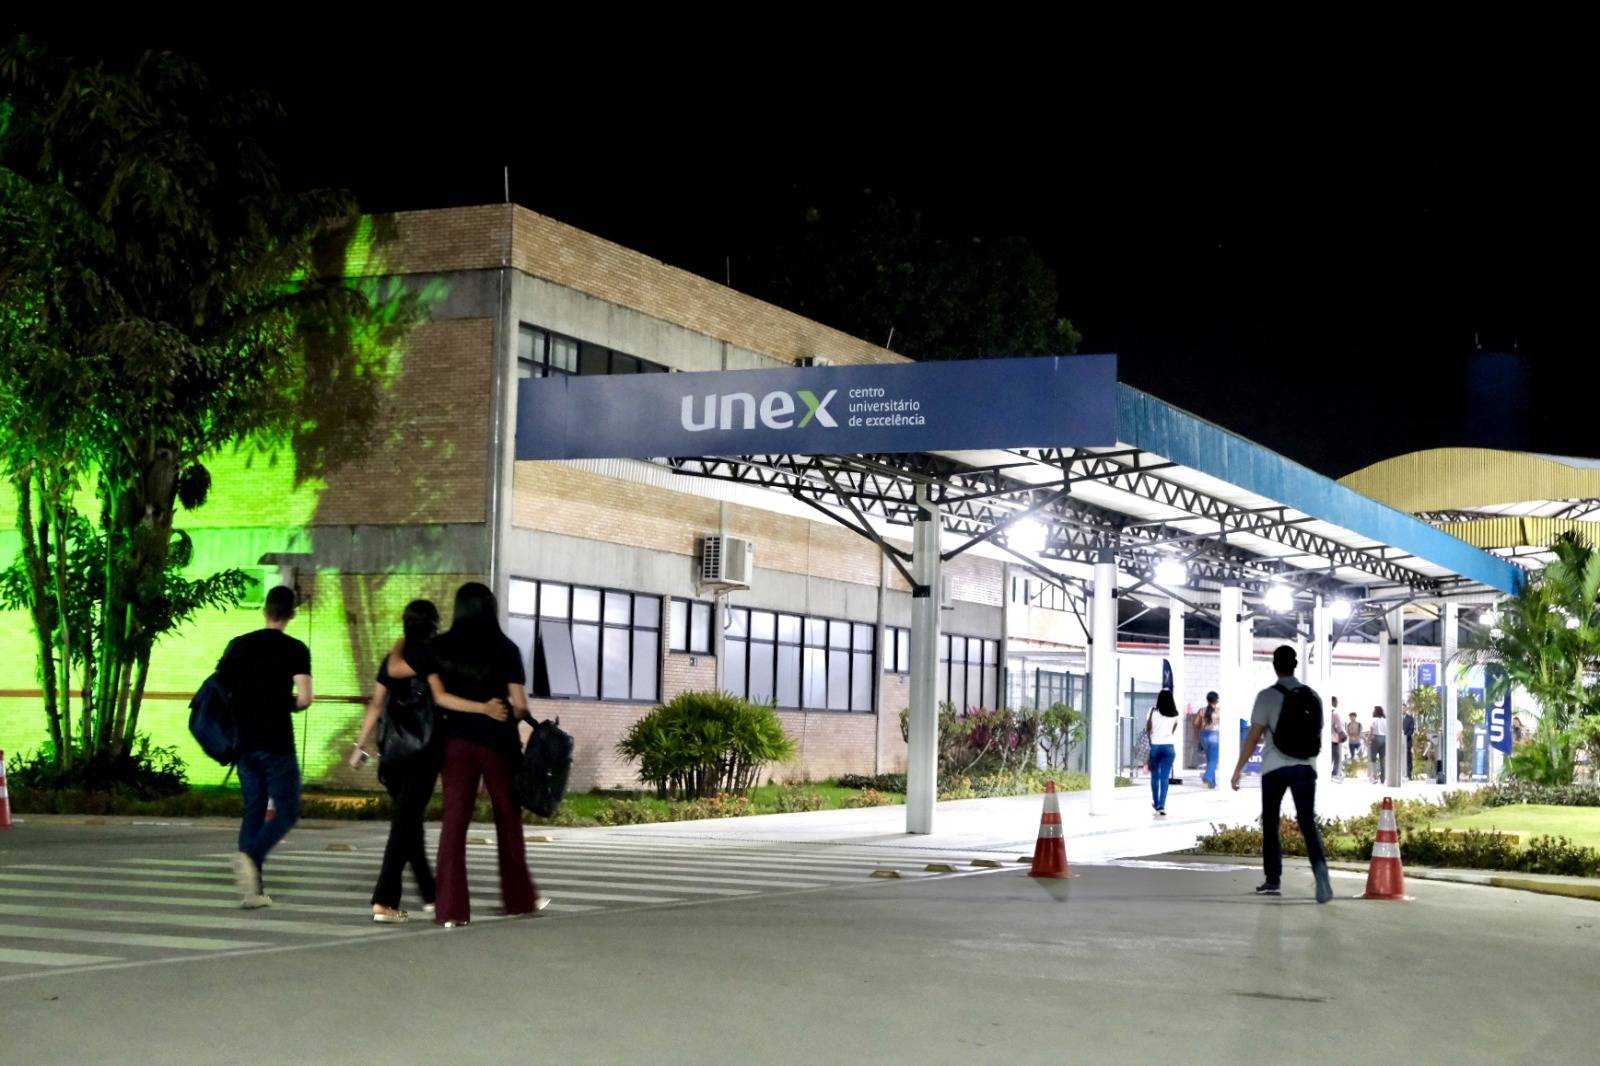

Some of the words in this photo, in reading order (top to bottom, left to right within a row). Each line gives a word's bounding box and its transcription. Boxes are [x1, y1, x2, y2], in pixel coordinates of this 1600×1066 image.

[849, 387, 885, 398] centro
[681, 389, 839, 432] unex
[849, 399, 920, 412] universitário
[848, 415, 862, 426] de
[865, 414, 925, 426] excelência
